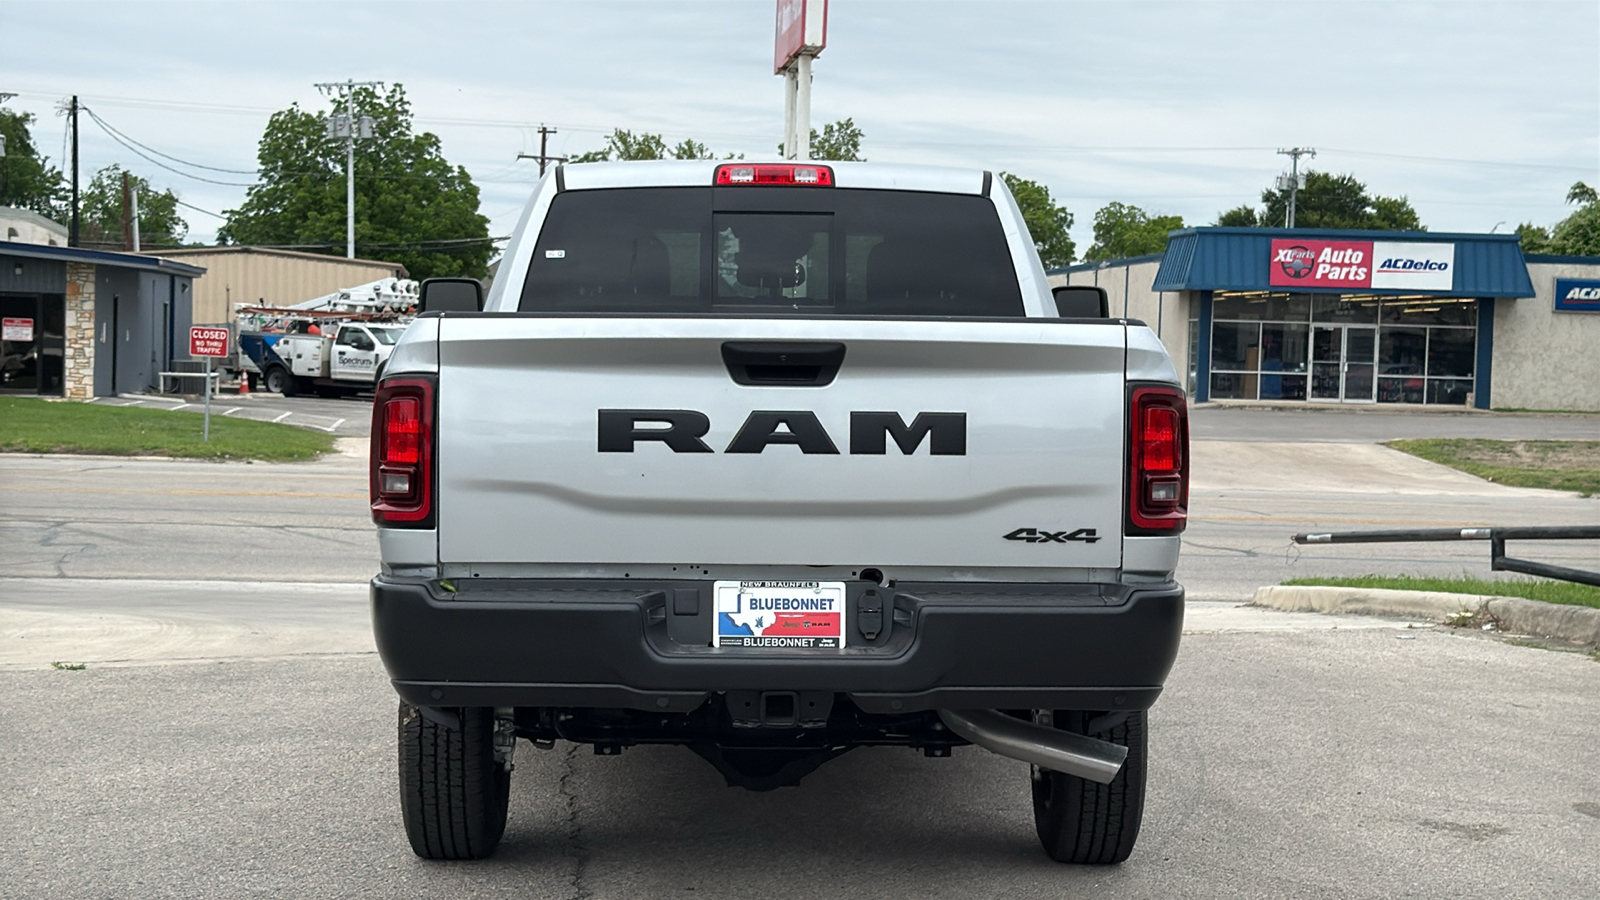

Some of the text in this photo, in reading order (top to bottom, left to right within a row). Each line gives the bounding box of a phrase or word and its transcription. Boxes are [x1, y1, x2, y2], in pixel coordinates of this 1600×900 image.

[1317, 247, 1364, 264] Auto
[1380, 258, 1449, 271] ACDelco
[1315, 263, 1368, 281] Parts
[192, 330, 227, 340] CLOSED
[338, 356, 371, 365] Spectrum
[597, 408, 967, 456] RAM
[1002, 528, 1102, 543] 4x4
[749, 598, 835, 611] BLUEBONNET
[743, 638, 815, 648] BLUEBONNET
